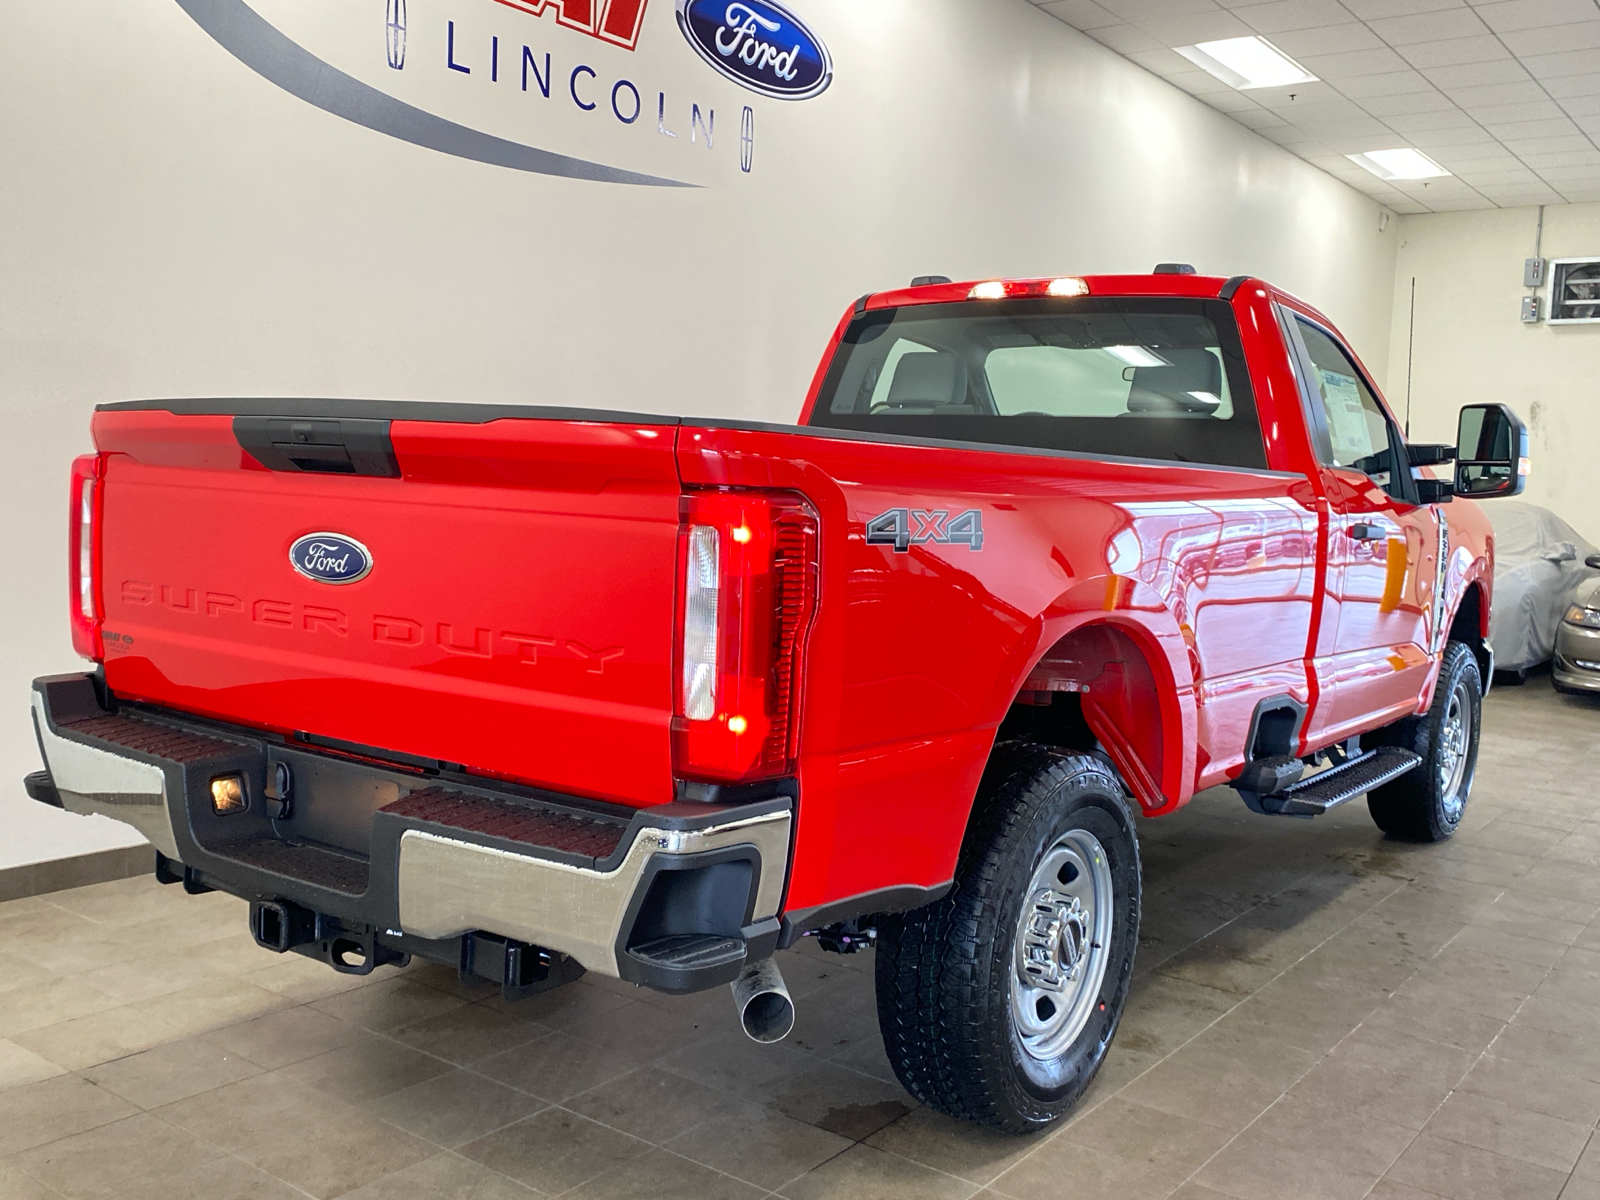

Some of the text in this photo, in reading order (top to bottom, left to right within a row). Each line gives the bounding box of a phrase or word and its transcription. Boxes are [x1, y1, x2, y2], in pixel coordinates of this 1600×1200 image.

[447, 20, 715, 149] LINCOLN
[715, 2, 801, 82] Ford
[304, 542, 350, 573] Ford
[121, 579, 625, 674] SUPER DUTY
